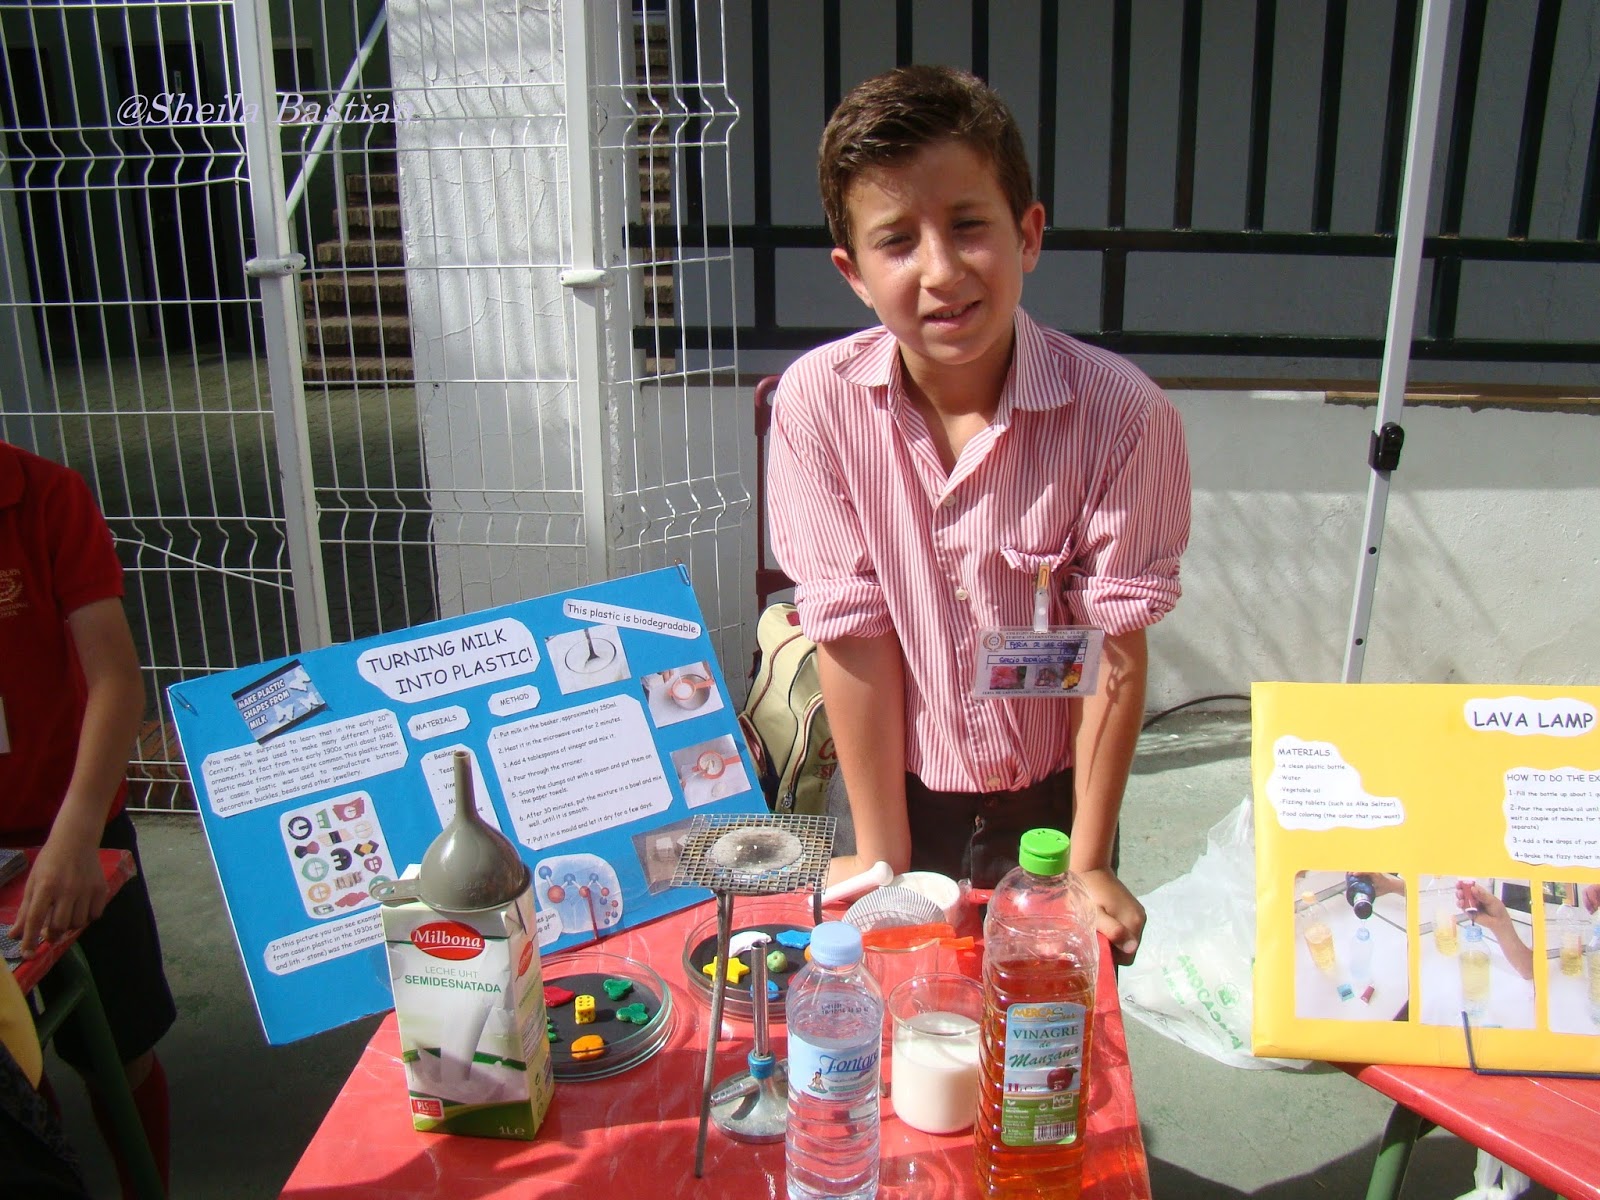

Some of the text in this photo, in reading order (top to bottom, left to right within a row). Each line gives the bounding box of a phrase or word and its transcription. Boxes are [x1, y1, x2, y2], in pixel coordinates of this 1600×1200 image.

[568, 603, 699, 634] This plastic is biodegradable.
[366, 628, 507, 673] TURNING MILK
[395, 647, 533, 695] INTO PLASTIC!
[237, 679, 286, 710] MAKE PLASTIC
[243, 689, 290, 720] SHAPES FROM
[500, 692, 530, 706] METHOD
[249, 715, 268, 730] MILK
[415, 714, 458, 732] MATERIALS
[561, 707, 599, 722] approximately
[600, 702, 617, 711] 250ml
[1473, 711, 1594, 729] LAVA LAMP
[223, 754, 241, 762] made
[256, 741, 286, 754] surprised
[299, 734, 316, 742] learn
[319, 729, 332, 737] that
[359, 719, 374, 727] early
[240, 759, 253, 768] milk
[272, 750, 288, 759] used
[302, 743, 318, 751] make
[321, 740, 338, 751] many
[341, 730, 369, 742] different
[373, 724, 393, 738] plastic
[504, 744, 518, 753] Heat
[543, 731, 571, 742] microwave
[258, 764, 272, 773] fact
[274, 760, 291, 768] from
[305, 751, 321, 760] early
[323, 746, 342, 755] 1900s
[344, 741, 358, 750] until
[359, 736, 377, 746] about
[1533, 774, 1546, 782] TO
[1588, 774, 1600, 782] EX
[219, 799, 253, 813] decorative
[281, 786, 300, 796] beads
[301, 782, 313, 790] and
[314, 778, 331, 786] other
[532, 793, 548, 803] paper
[272, 944, 281, 952] In
[281, 940, 295, 948] this
[296, 933, 319, 945] picture
[320, 929, 332, 937] you
[344, 921, 356, 929] see
[273, 952, 289, 961] from
[291, 946, 311, 956] casein
[312, 938, 333, 951] plastic
[354, 925, 373, 935] 1930s
[413, 928, 483, 949] Milbona
[276, 961, 288, 971] and
[289, 958, 301, 966] lith
[307, 949, 327, 961] stone)
[328, 946, 340, 954] was
[404, 974, 502, 993] SEMIDESNATADA
[425, 966, 479, 979] LECHE UHT
[1013, 1025, 1079, 1040] VINAGRE
[1039, 1040, 1051, 1049] de
[1008, 1045, 1080, 1068] Manzana
